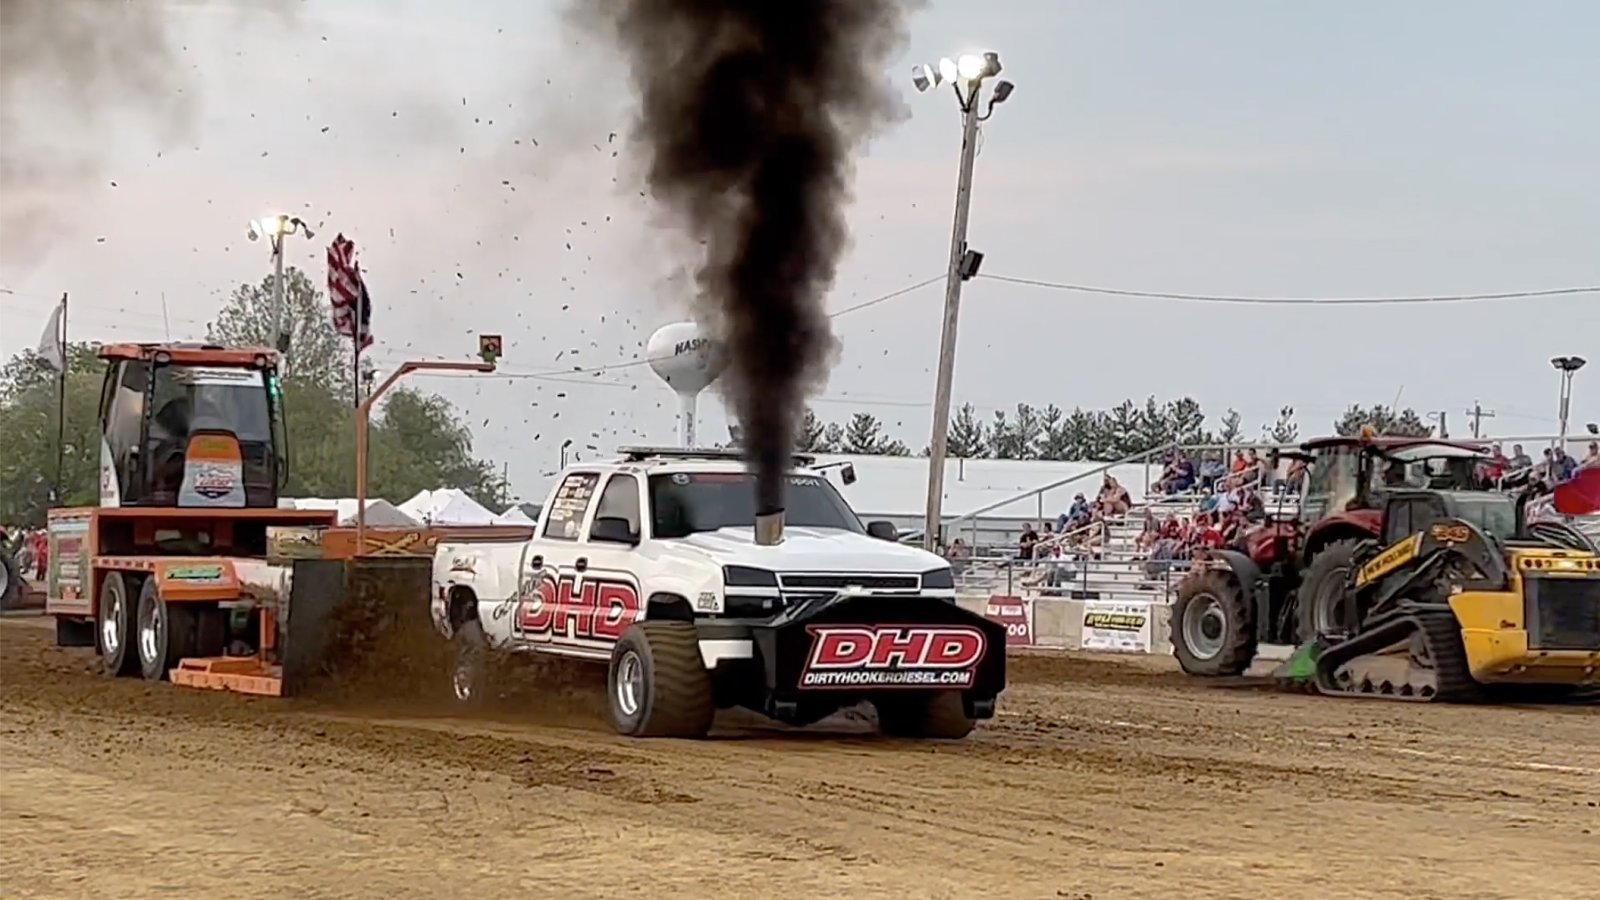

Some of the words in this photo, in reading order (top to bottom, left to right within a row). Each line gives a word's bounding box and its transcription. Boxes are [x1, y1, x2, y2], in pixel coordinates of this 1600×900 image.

[514, 574, 640, 640] DHD
[1003, 623, 1027, 636] 00
[809, 629, 983, 669] DHD
[804, 671, 970, 684] DIRTYHOOKERDIESEL.COM
